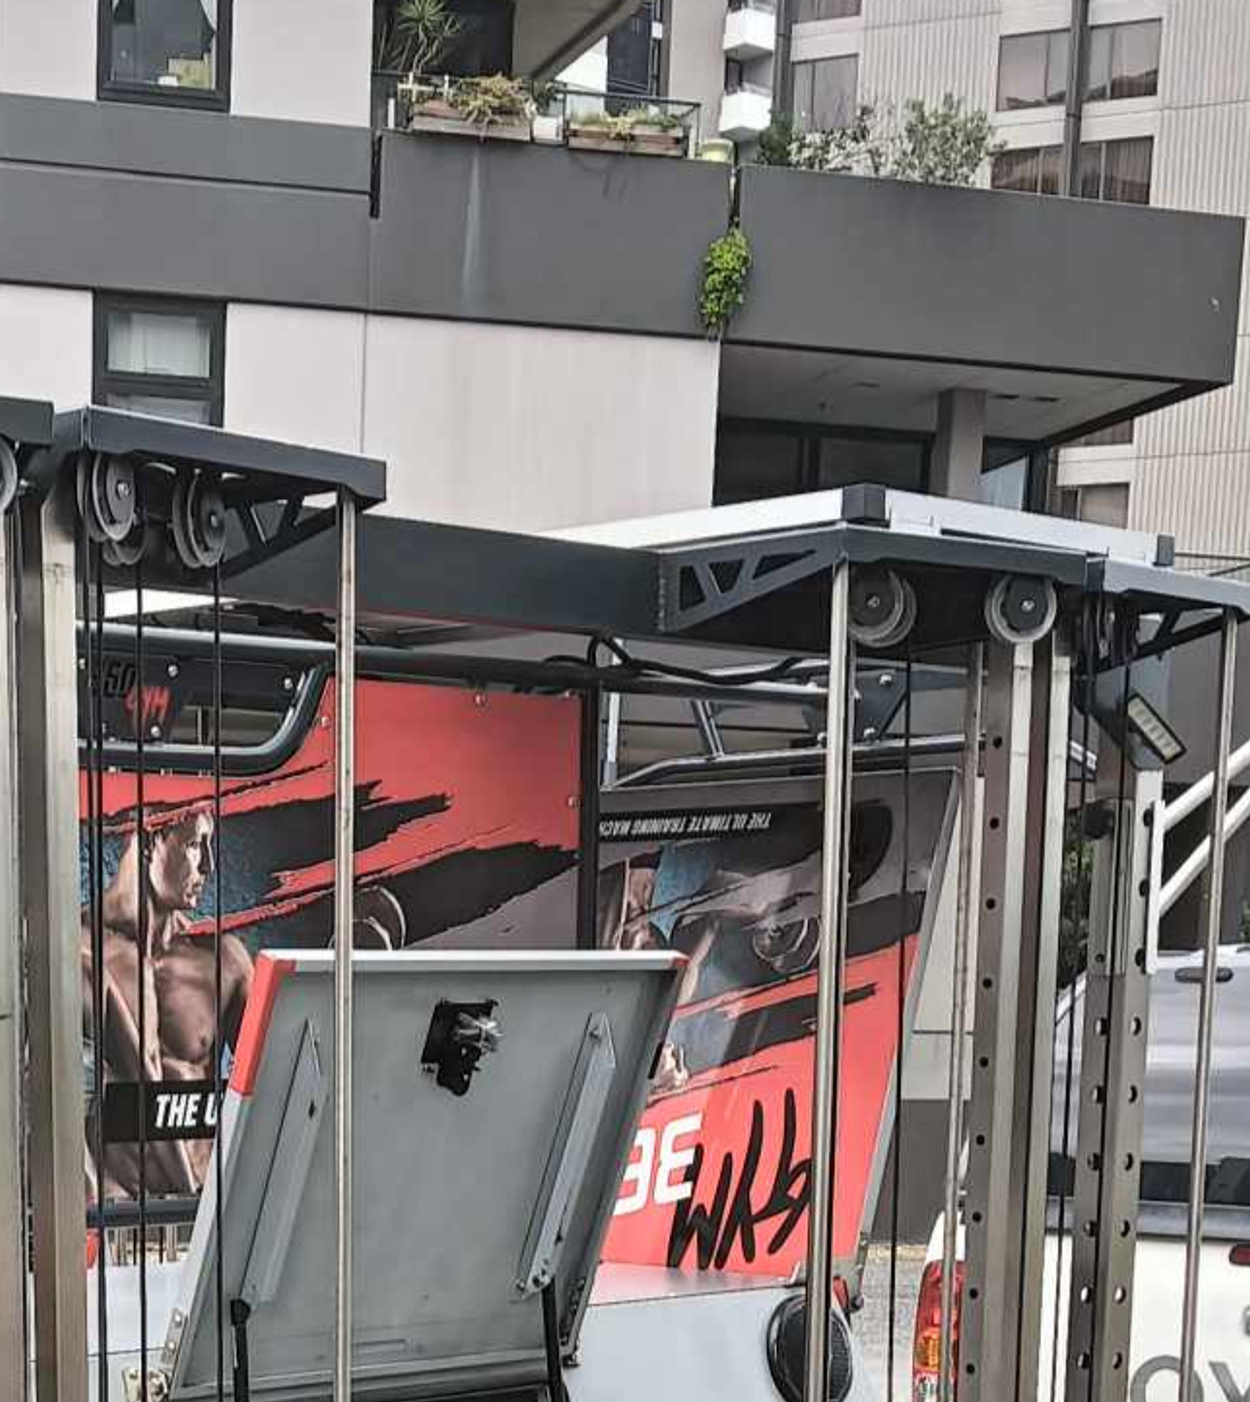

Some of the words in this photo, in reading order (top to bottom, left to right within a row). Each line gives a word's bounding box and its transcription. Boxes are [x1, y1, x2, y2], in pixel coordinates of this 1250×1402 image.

[631, 816, 686, 835] TRAINING
[687, 813, 748, 833] ULTIMATE
[154, 1092, 202, 1128] THE
